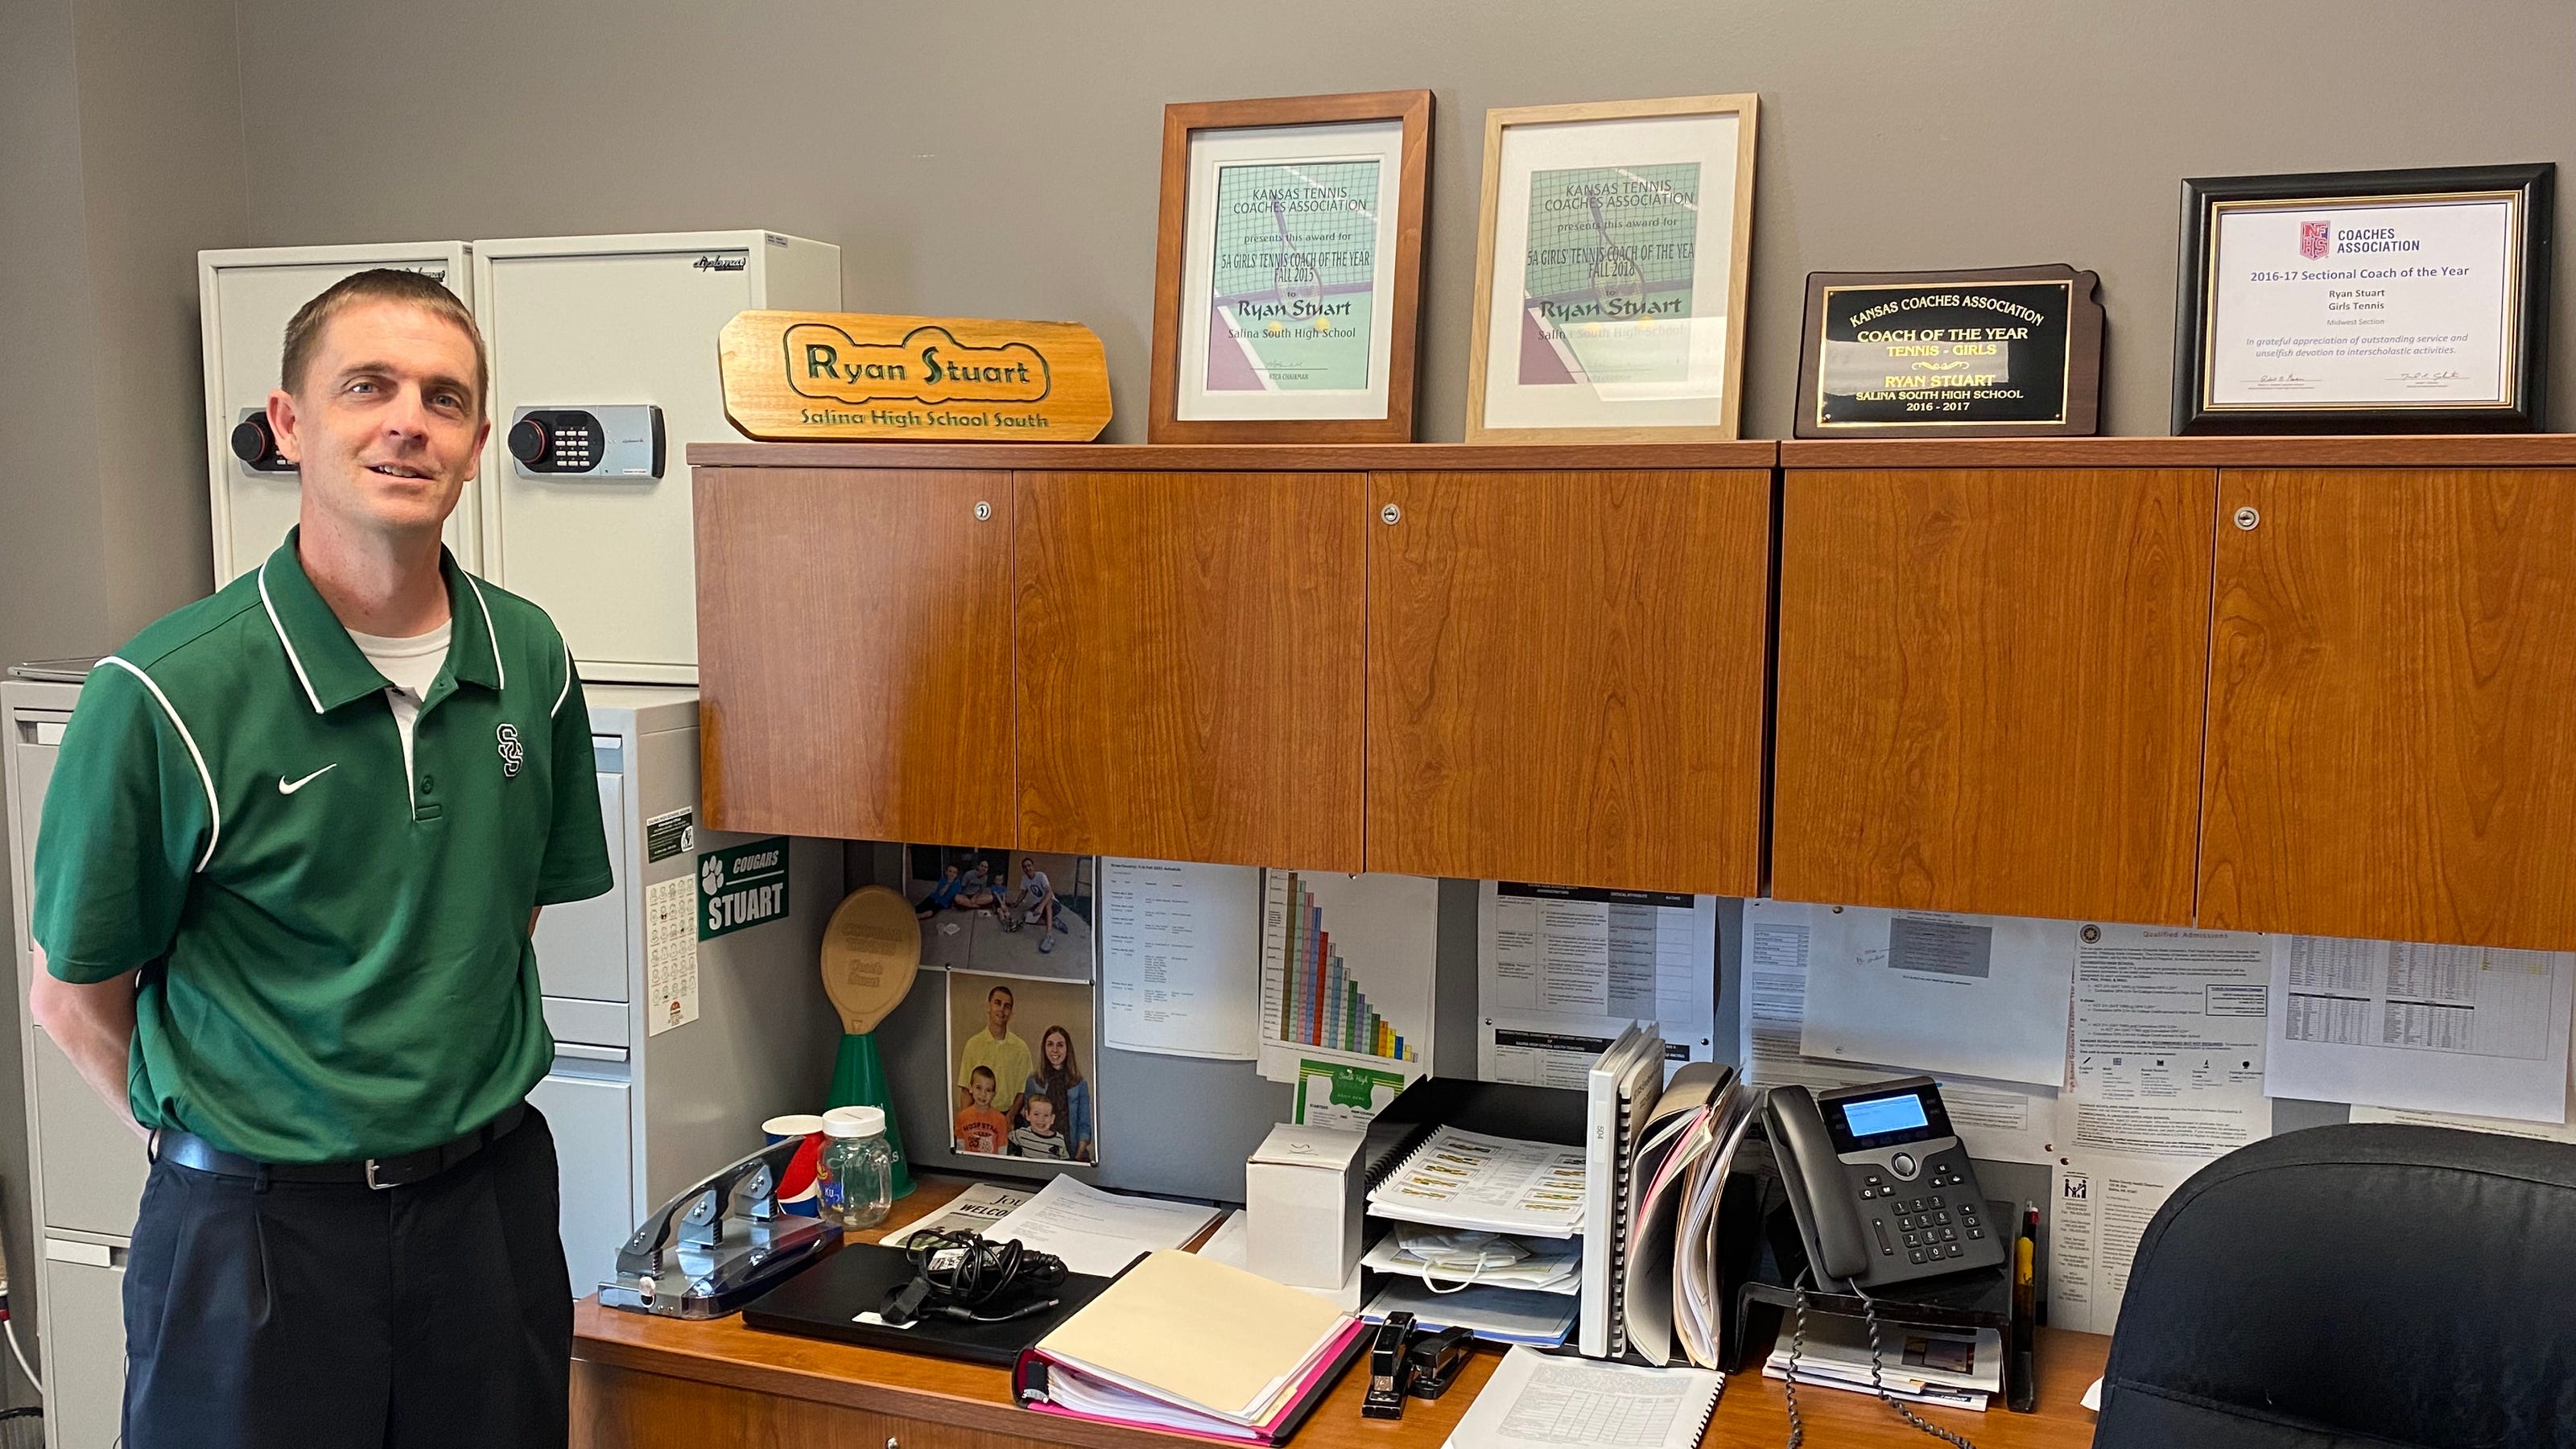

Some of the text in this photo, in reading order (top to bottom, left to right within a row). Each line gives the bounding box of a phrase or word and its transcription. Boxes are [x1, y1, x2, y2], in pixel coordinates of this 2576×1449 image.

[1253, 187, 1348, 201] KANSAS TENNIS
[1566, 180, 1671, 196] KANSAS TENNIS
[1233, 199, 1367, 214] COACHES ASSOCIATION
[1546, 192, 1694, 211] COACHES ASSOCIATION
[1557, 217, 1678, 233] presents this award for
[1245, 232, 1352, 245] presents this award for
[2338, 229, 2396, 242] COACHES
[1526, 243, 1695, 266] 5A GIRLS' TENNIS COACH OF THE YEA
[2336, 240, 2420, 254] ASSOCIATION
[1221, 250, 1370, 269] 5A GIRLS' TENNIS COACH OF THE YEAR
[1275, 267, 1314, 282] FALL 2015
[1588, 261, 1635, 279] FALL 2018
[2251, 266, 2470, 282] 2016-17 Sectional Coach of the Year
[2328, 288, 2385, 299] Ryan Stuart
[1238, 299, 1351, 320] Ryan Stuart
[1539, 298, 1682, 321] Ryan Stuart
[1850, 295, 2045, 328] KANSAS COACHES ASSOCIATION
[2328, 301, 2384, 311] Girls Tennis
[1228, 327, 1356, 340] Salina South High School
[1578, 327, 1609, 339] South
[1613, 325, 1639, 340] High
[1645, 324, 1684, 336] School
[1857, 327, 2029, 343] COACH OF THE YEAR
[2246, 333, 2469, 347] In grateful appreciation of outstanding service and
[1886, 345, 1940, 357] TENNIS
[1952, 343, 1997, 356] GIRLS
[2256, 348, 2293, 358] unselfish
[2295, 348, 2334, 356] devotion
[2347, 346, 2412, 356] interscholastic
[2413, 346, 2455, 354] activities.
[805, 343, 1030, 386] Ryan Stuart
[1884, 374, 1996, 388] RYAN STUART
[1855, 390, 2024, 402] SALINA SOUTH HIGH SCHOOL
[1906, 402, 1934, 412] 2016
[1942, 402, 1971, 412] 2017
[801, 409, 1050, 428] Salina High School South
[733, 850, 779, 874] COUGARS
[708, 882, 784, 931] STUART
[2143, 931, 2228, 939] Qualified Admissions
[989, 1195, 1027, 1206] JOU
[960, 1204, 1013, 1217] WELCO
